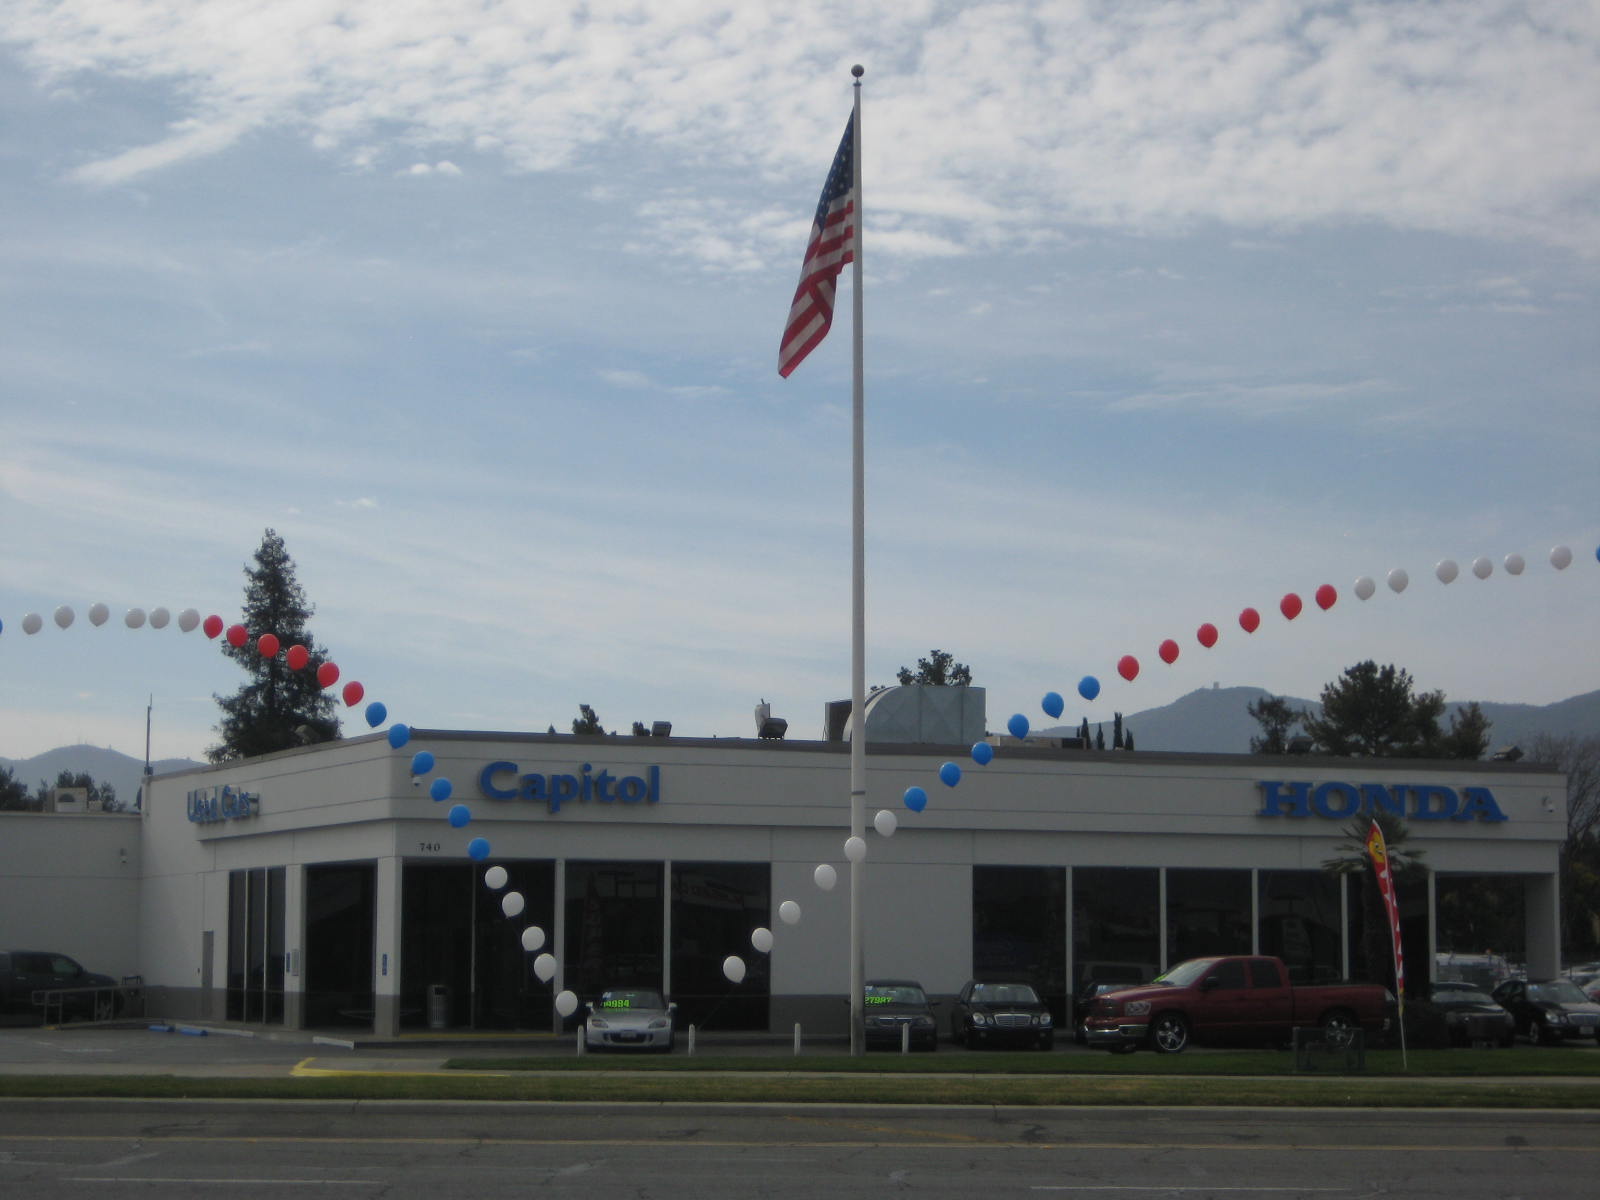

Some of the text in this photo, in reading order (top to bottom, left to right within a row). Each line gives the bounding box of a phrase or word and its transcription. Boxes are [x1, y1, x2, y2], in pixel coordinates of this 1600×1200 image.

[479, 760, 661, 813] Capitol
[1256, 780, 1509, 822] HONDA
[418, 842, 441, 852] 740
